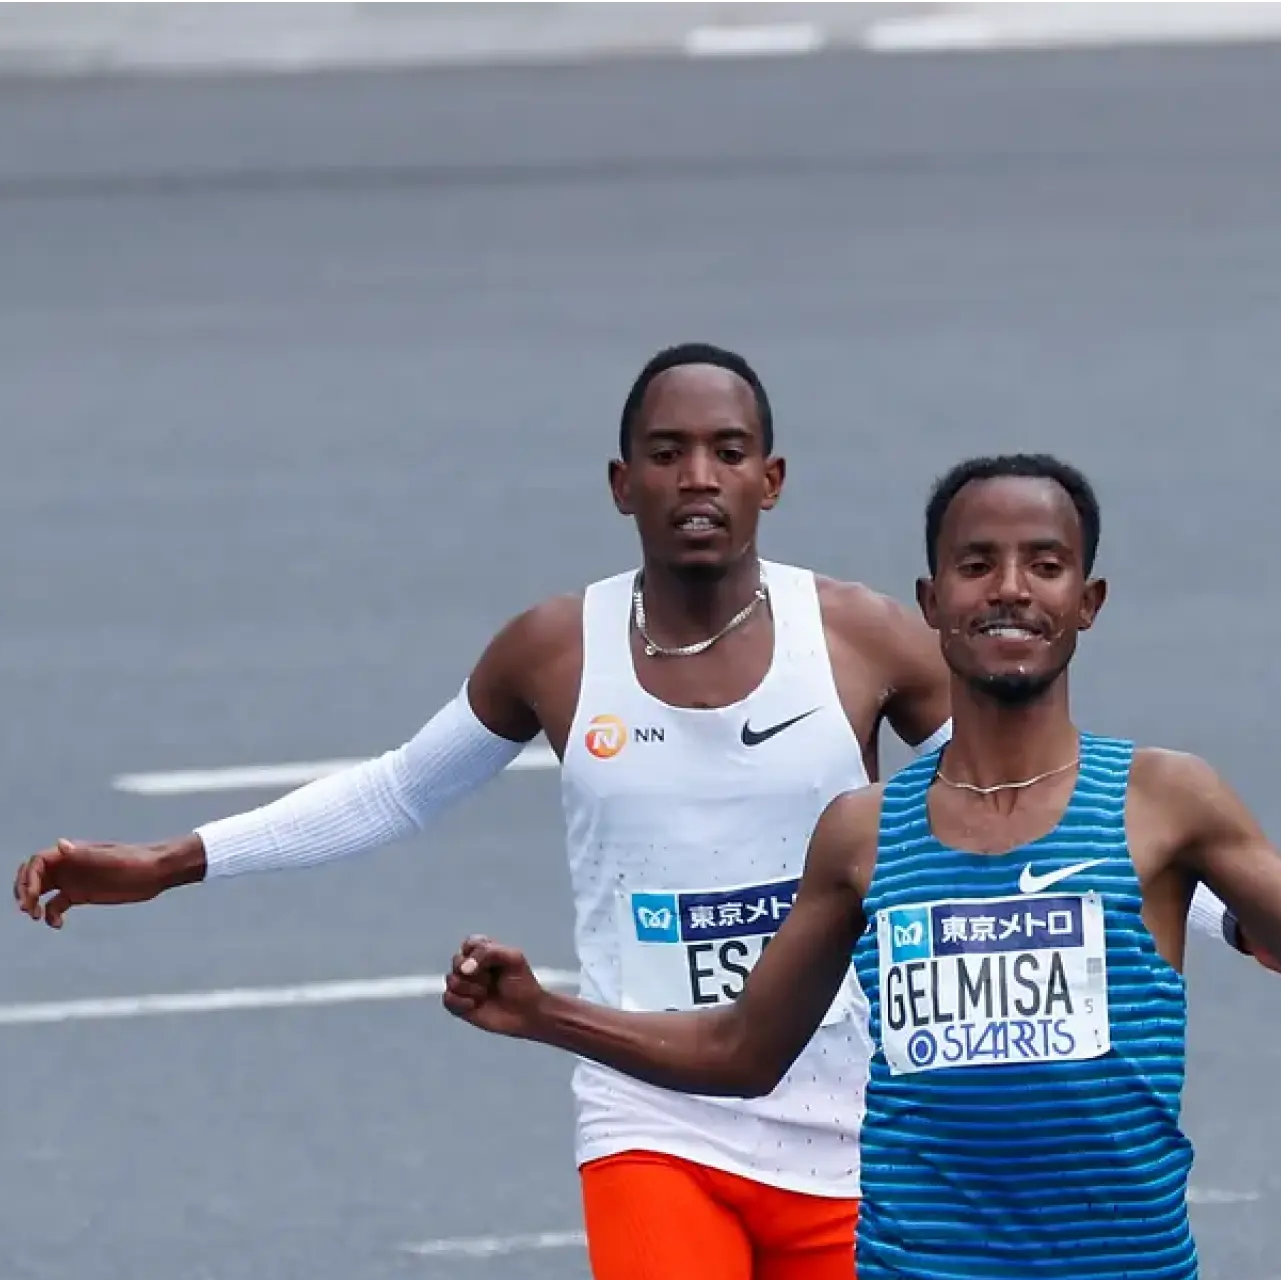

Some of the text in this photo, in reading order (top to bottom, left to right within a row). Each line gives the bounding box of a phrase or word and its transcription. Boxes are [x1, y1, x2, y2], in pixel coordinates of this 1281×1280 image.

[634, 726, 665, 743] NN
[687, 893, 798, 929] 東京メト
[940, 910, 1073, 943] 東京メトロ
[687, 935, 772, 1005] ES
[887, 950, 1074, 1031] GELMISA
